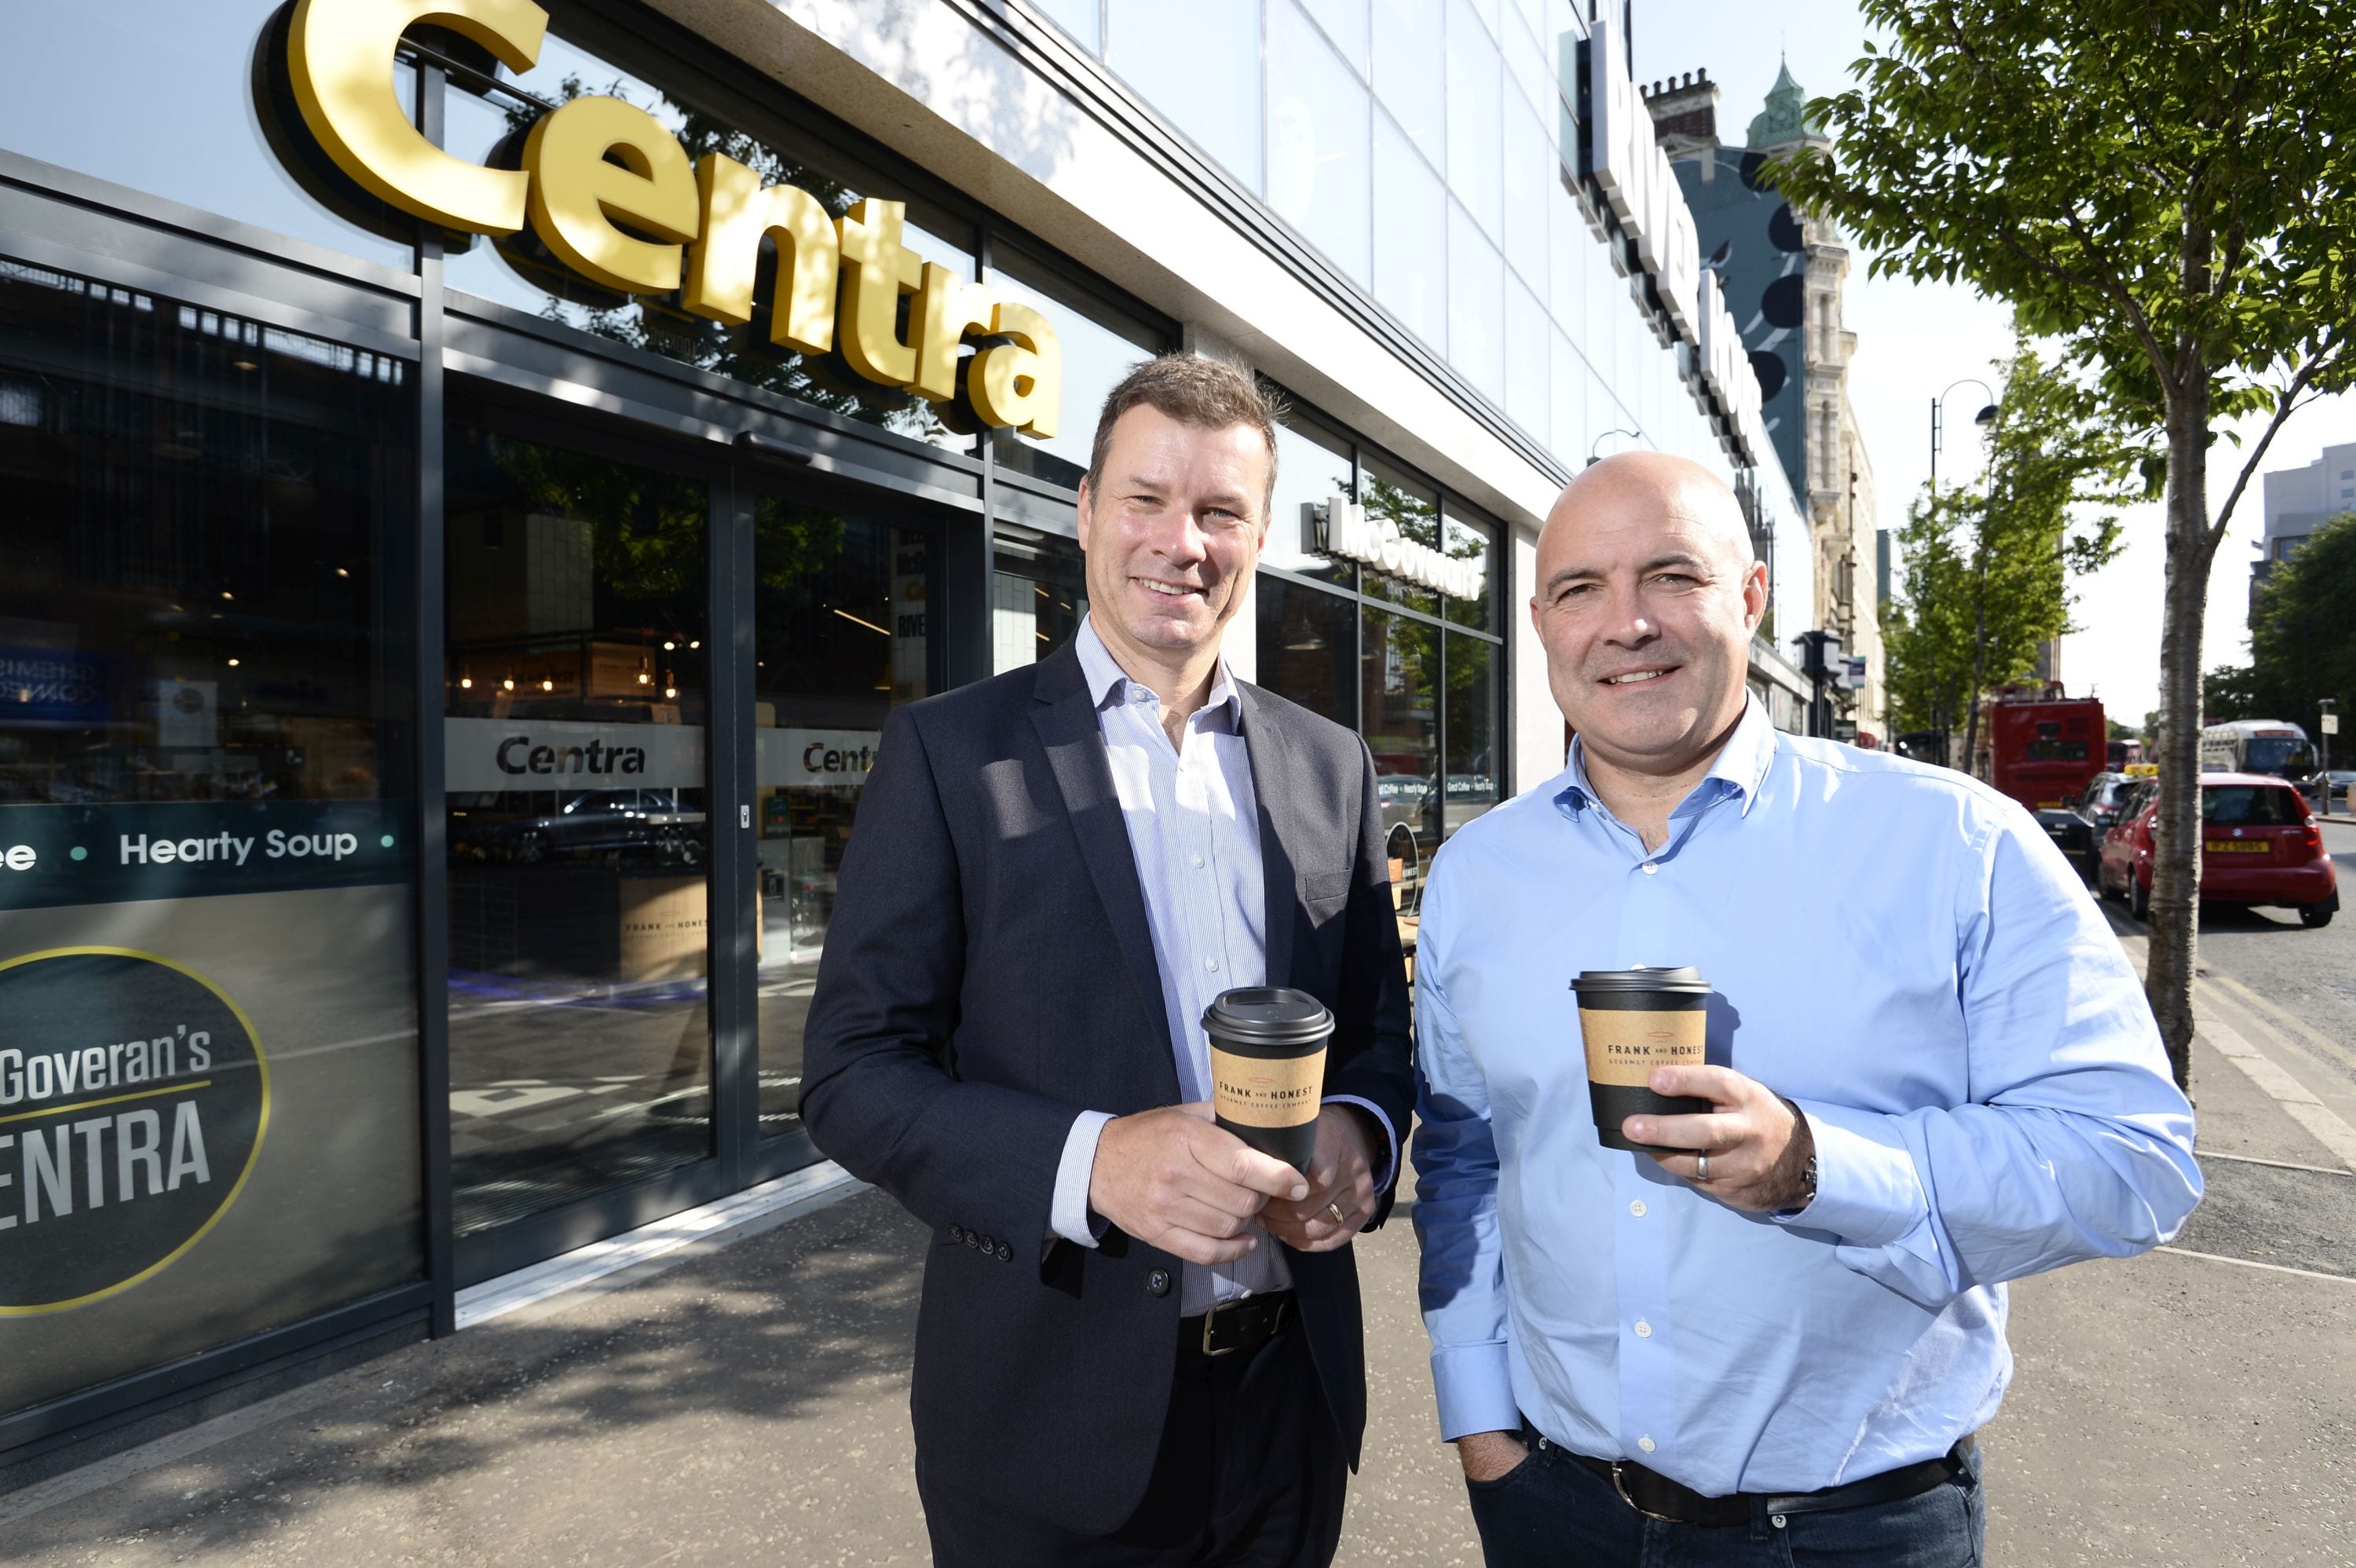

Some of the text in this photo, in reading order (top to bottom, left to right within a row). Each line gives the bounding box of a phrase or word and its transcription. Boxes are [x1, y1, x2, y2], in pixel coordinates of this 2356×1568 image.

[287, 0, 1063, 440] Centra
[496, 736, 646, 775] Centra
[120, 831, 255, 867] Hearty
[265, 829, 358, 861] Soup
[1608, 1044, 1650, 1055] FRANK
[1220, 1081, 1251, 1098] FRANK
[1271, 1085, 1313, 1099] HONEST
